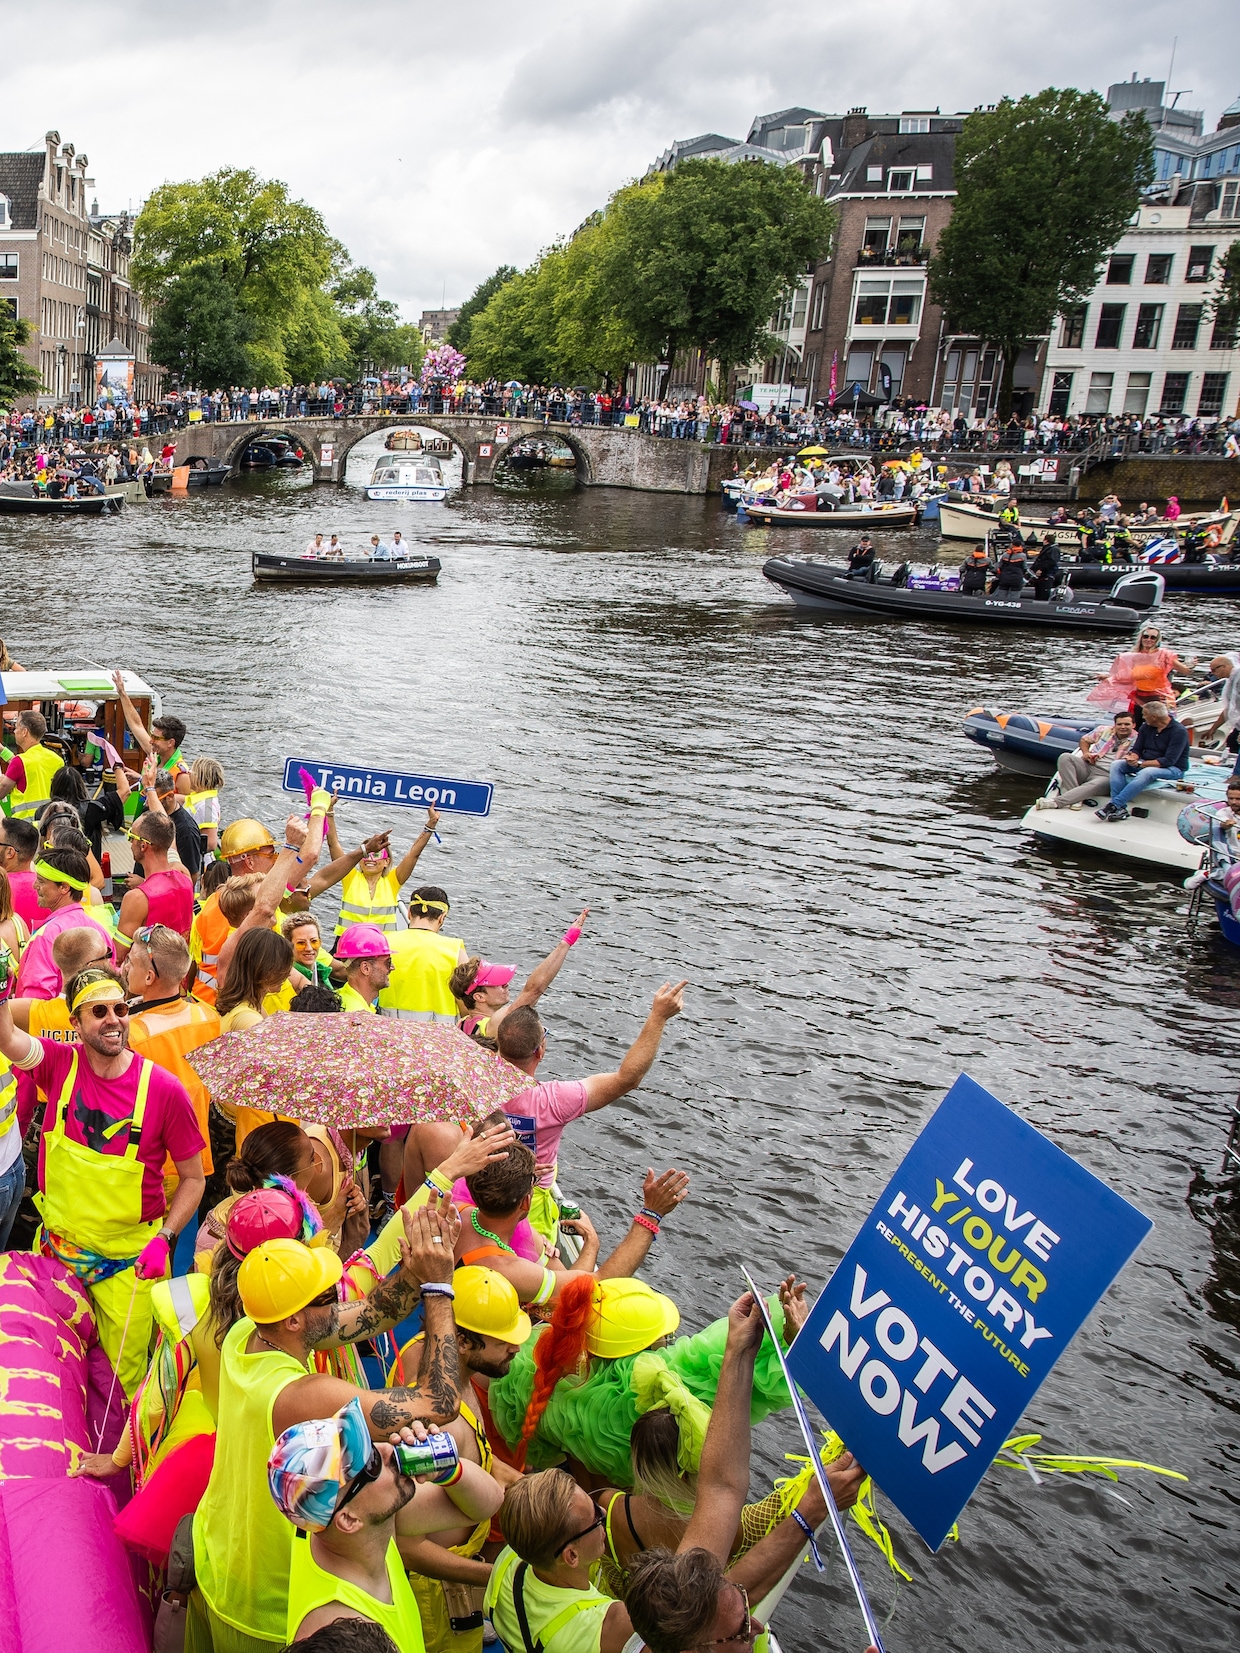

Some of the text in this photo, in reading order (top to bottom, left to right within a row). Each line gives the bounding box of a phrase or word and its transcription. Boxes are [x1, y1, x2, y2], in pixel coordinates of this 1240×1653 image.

[1056, 606, 1095, 614] LOMAC
[1101, 564, 1151, 572] POLITIE
[317, 768, 457, 805] Tania Leon
[886, 1190, 1054, 1350] HISTORY
[929, 1177, 1049, 1304] Y/OUR
[951, 1157, 1061, 1261] LOVE
[848, 1263, 997, 1449] VOTE
[875, 1220, 1032, 1378] REPRESENT THE FUTURE
[818, 1308, 969, 1475] NOW
